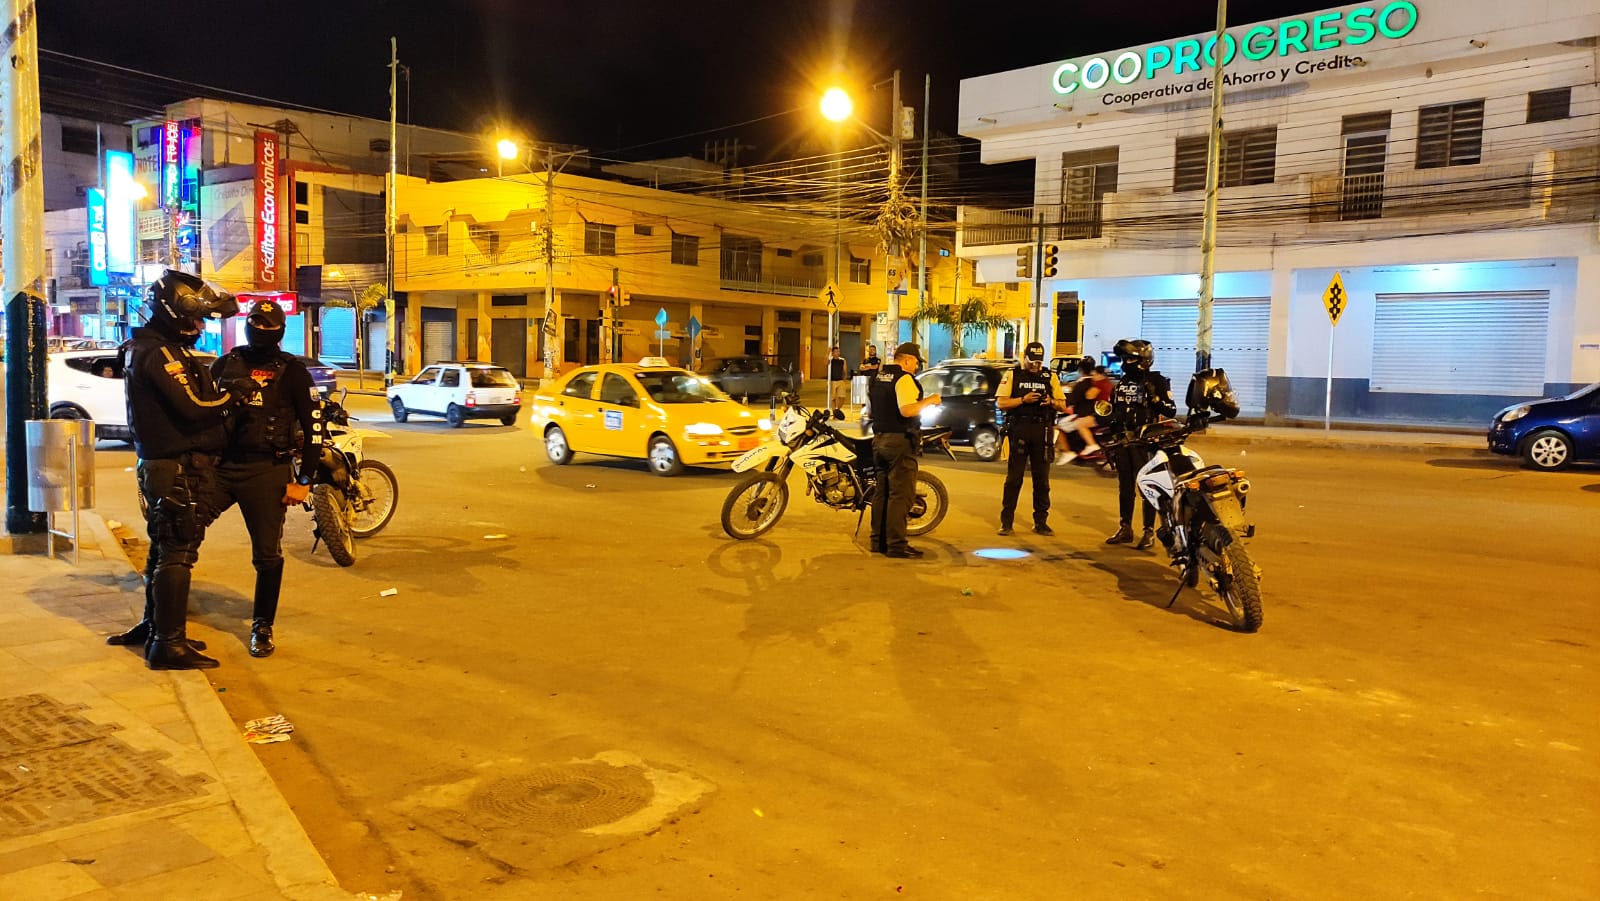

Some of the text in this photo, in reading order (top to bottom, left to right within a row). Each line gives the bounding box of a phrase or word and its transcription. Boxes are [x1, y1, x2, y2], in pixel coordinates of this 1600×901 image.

[1051, 1, 1418, 95] COOPROGRESO
[1102, 81, 1194, 106] Cooperativa
[1197, 77, 1214, 92] de
[1222, 70, 1276, 86] Ahorro
[1281, 68, 1290, 82] y
[260, 224, 275, 283] Créditos
